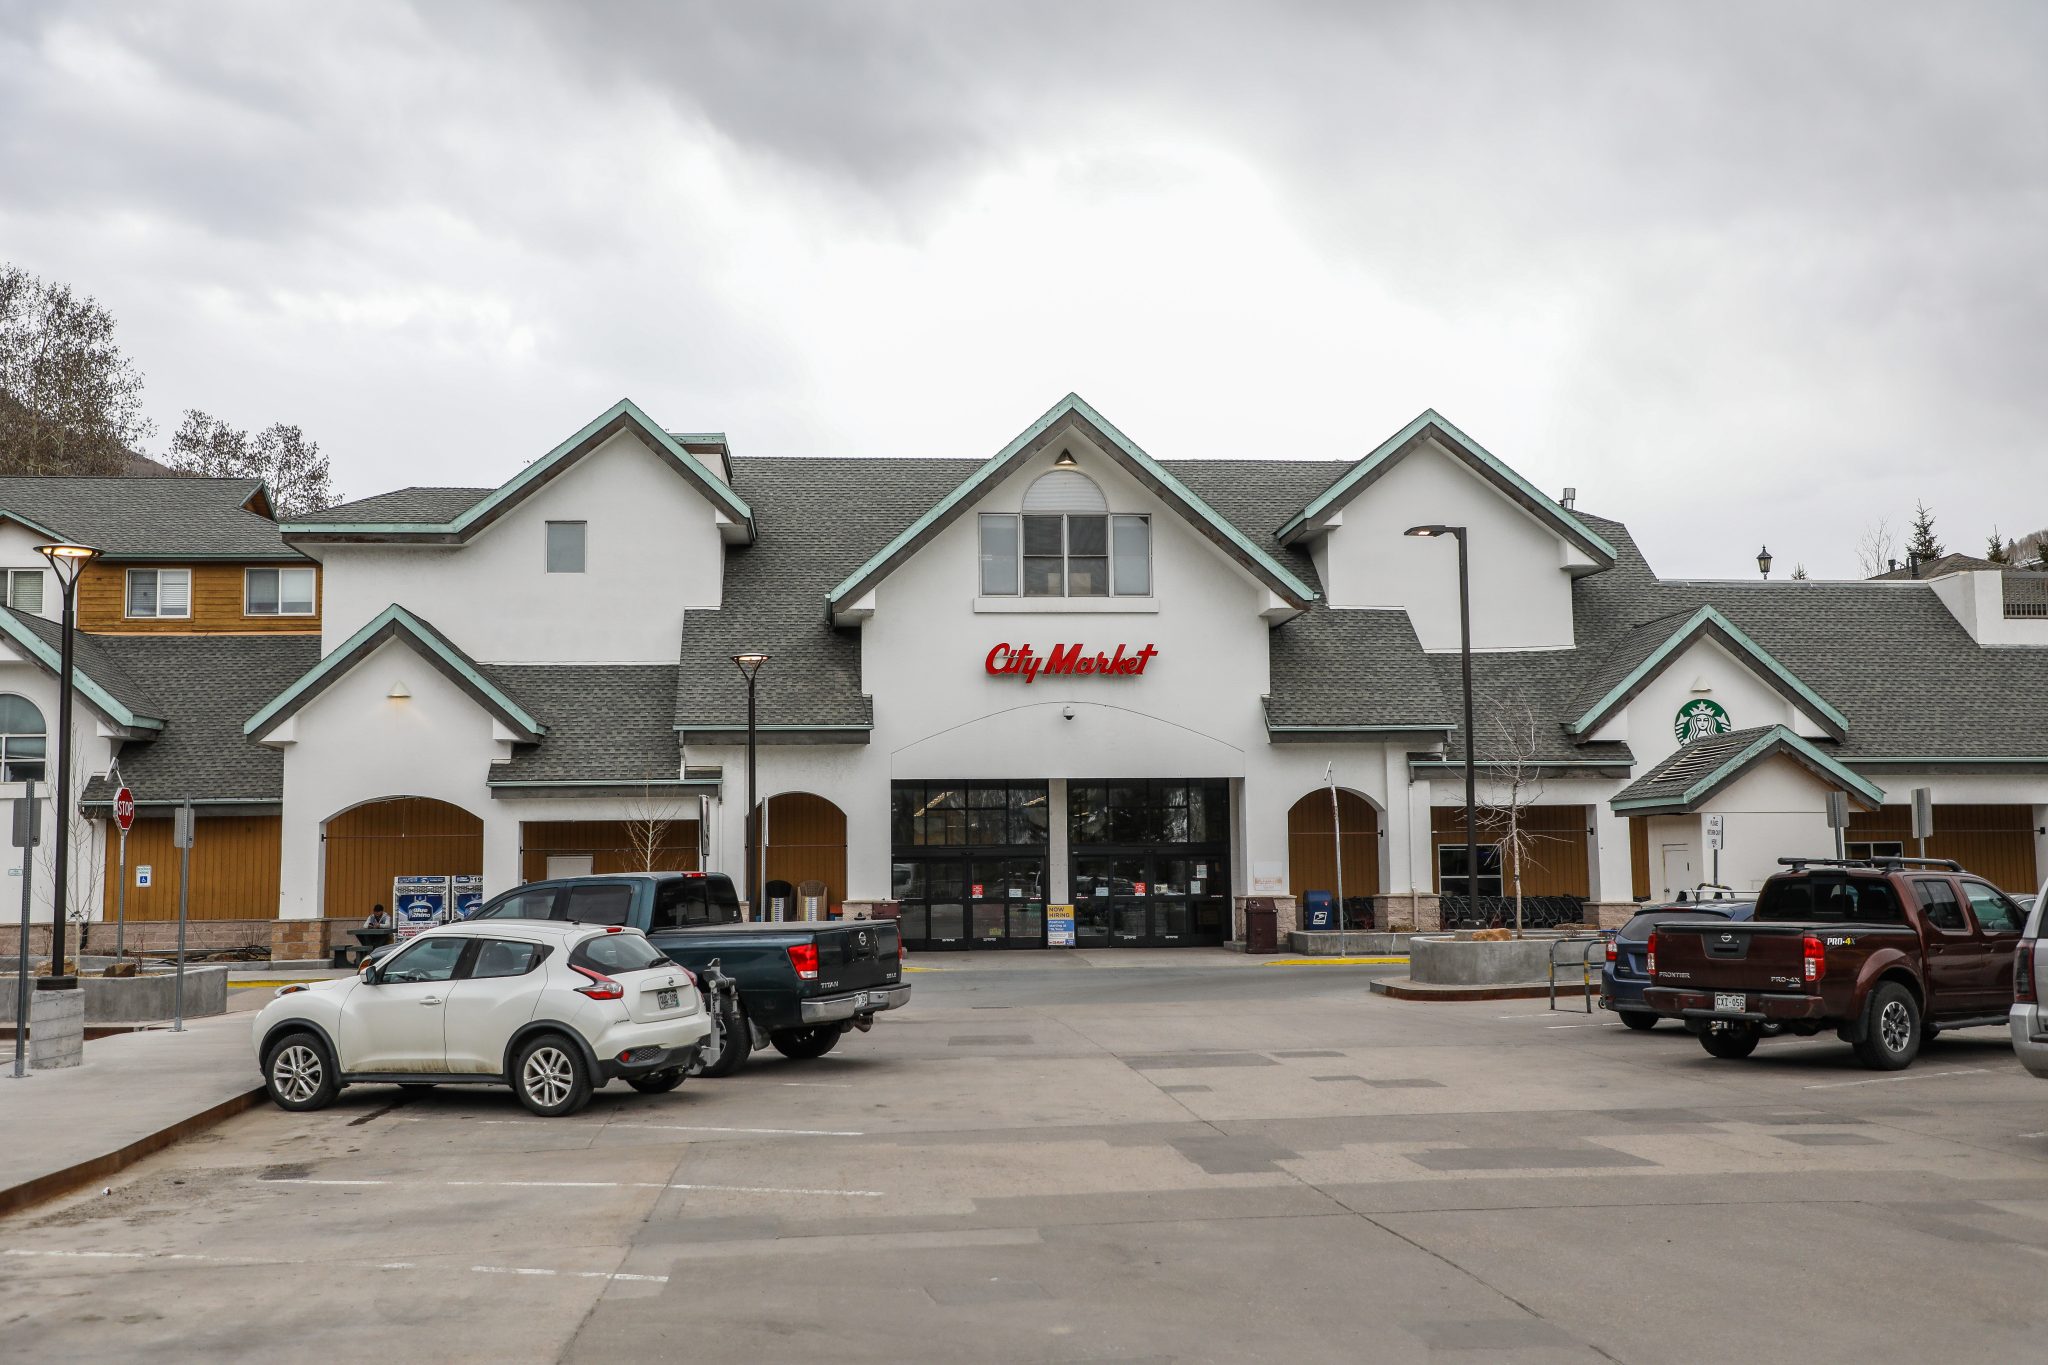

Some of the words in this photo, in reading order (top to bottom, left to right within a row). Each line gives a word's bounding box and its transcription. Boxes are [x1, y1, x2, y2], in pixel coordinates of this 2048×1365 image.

[985, 642, 1042, 684] City
[1043, 643, 1159, 676] Market
[118, 800, 133, 817] STOP
[1658, 971, 1691, 979] FRONTIER
[820, 981, 839, 989] TITAN
